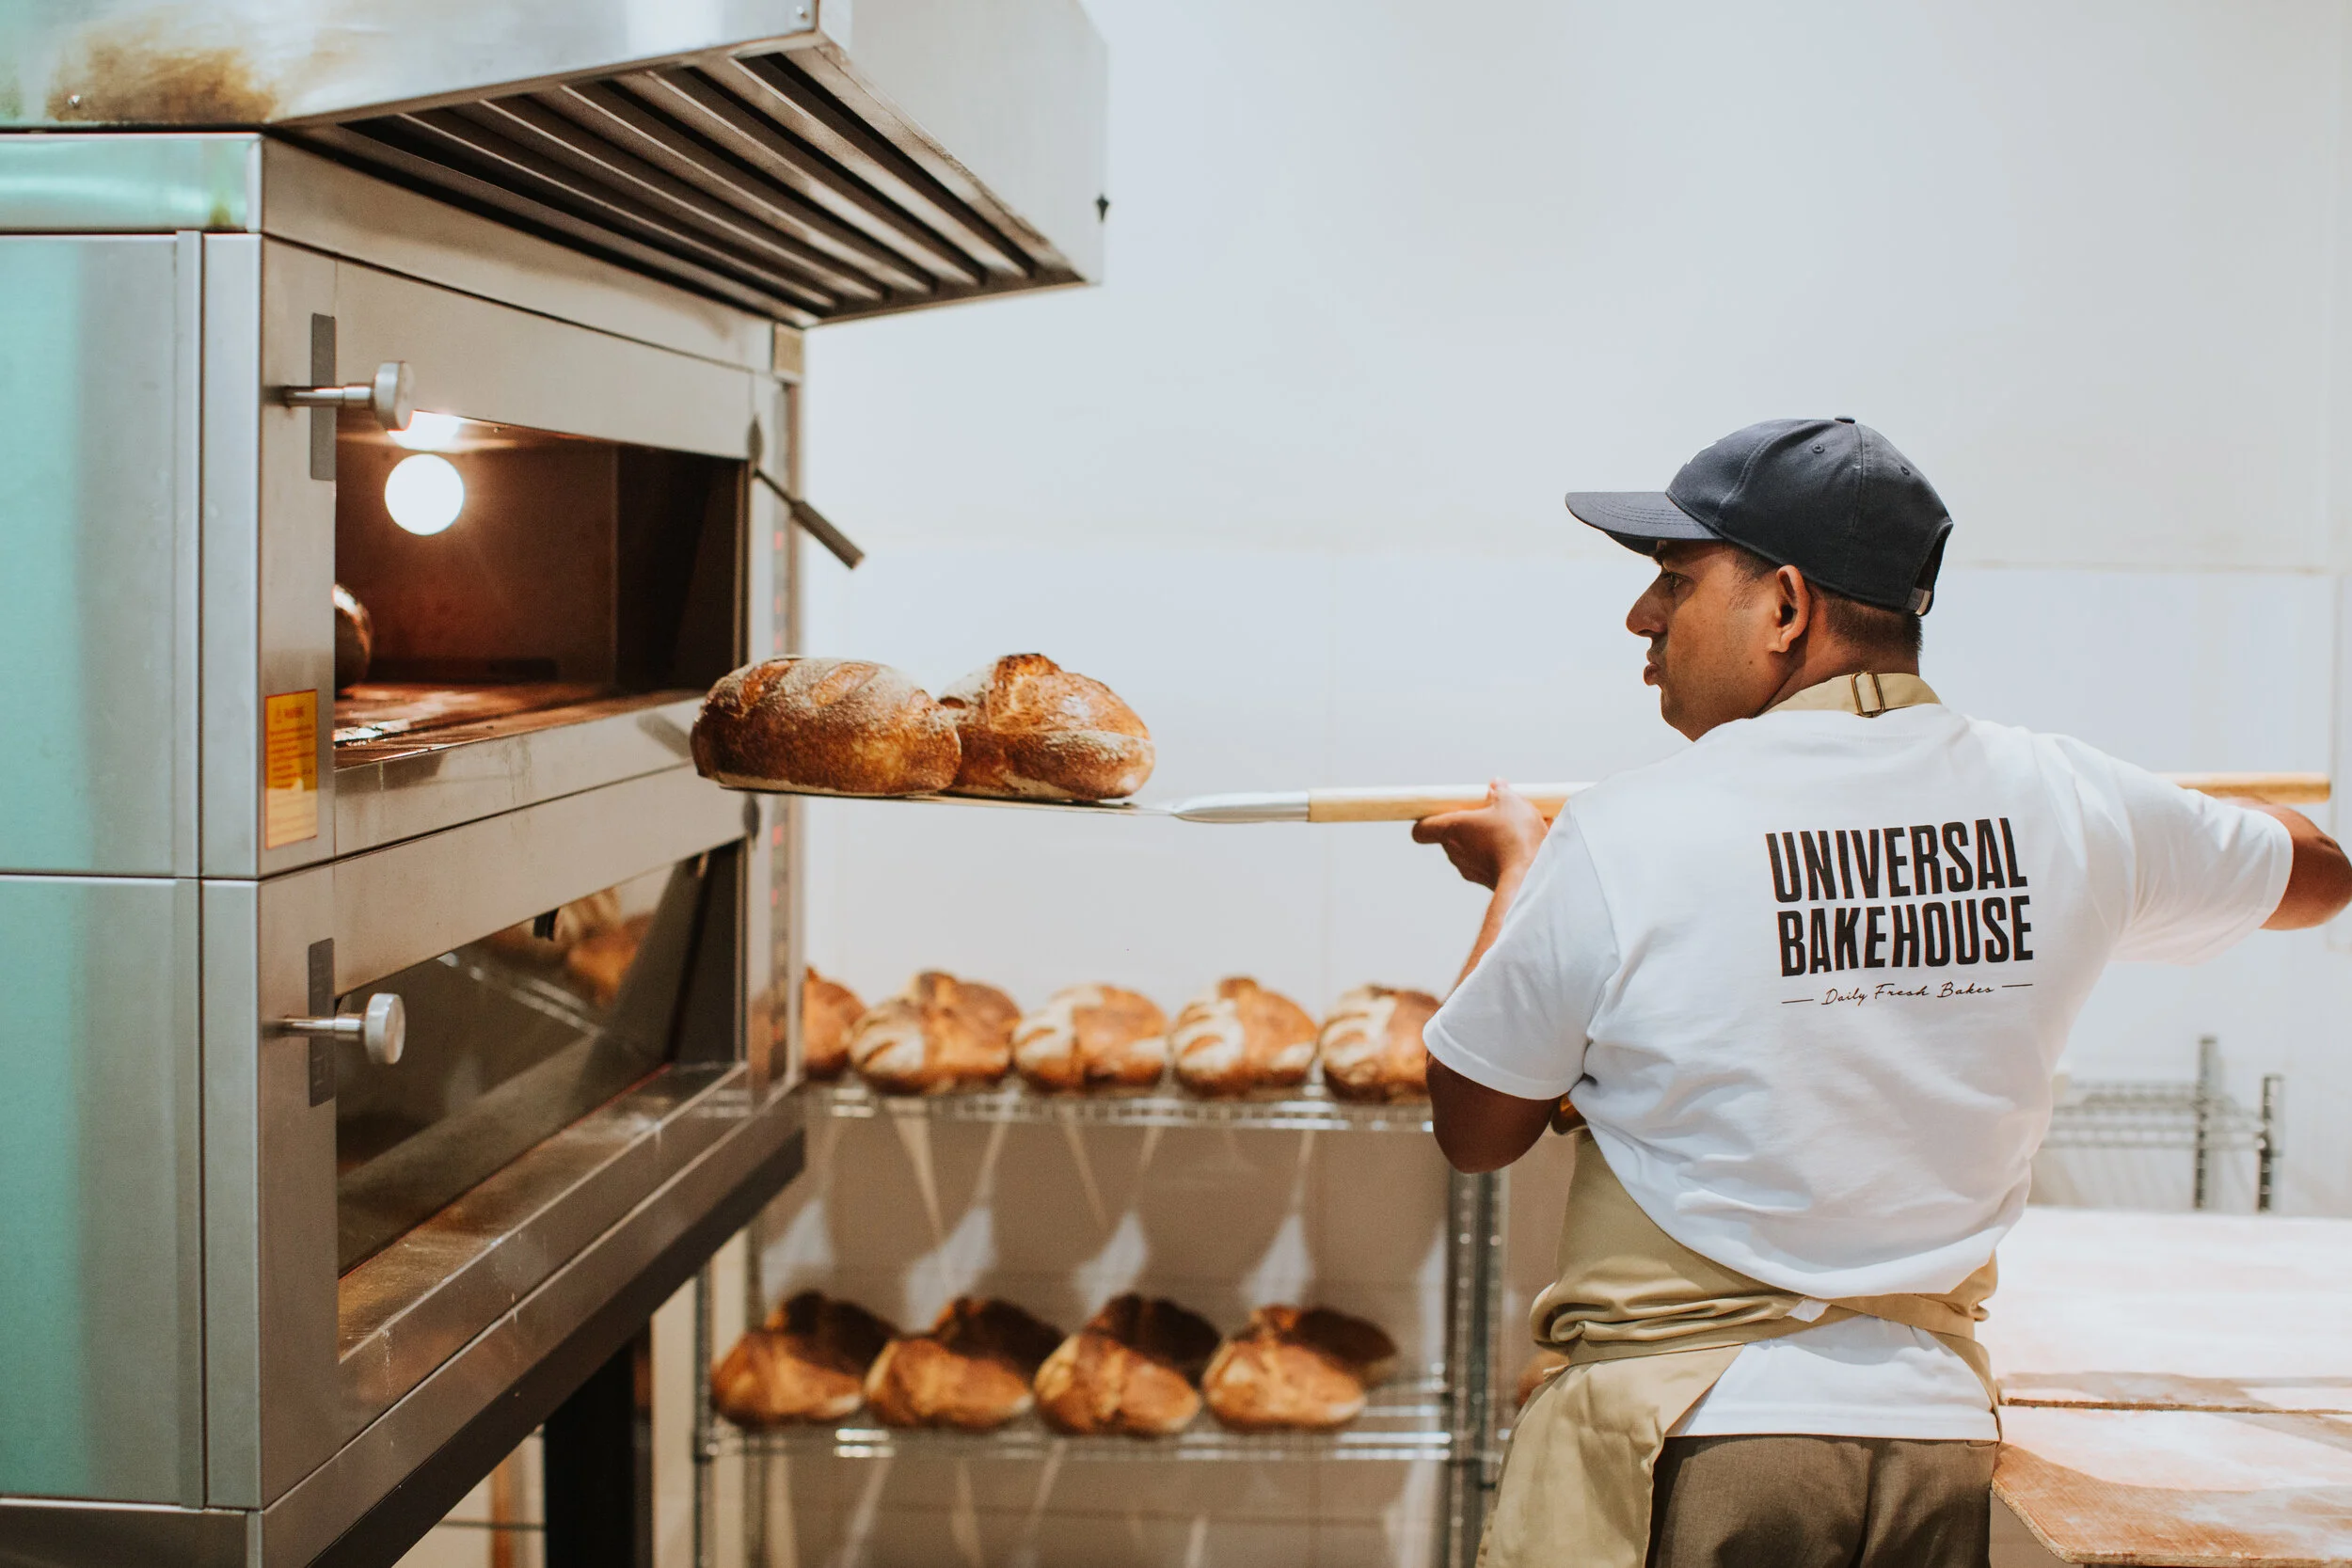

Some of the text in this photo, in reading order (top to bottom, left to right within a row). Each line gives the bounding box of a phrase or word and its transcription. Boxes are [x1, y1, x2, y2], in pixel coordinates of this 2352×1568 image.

[1765, 817, 2028, 904] UNIVERSAL
[1777, 895, 2034, 977] BAKEHOUSE
[1820, 981, 1995, 1006] Daily Fresh Bakes
